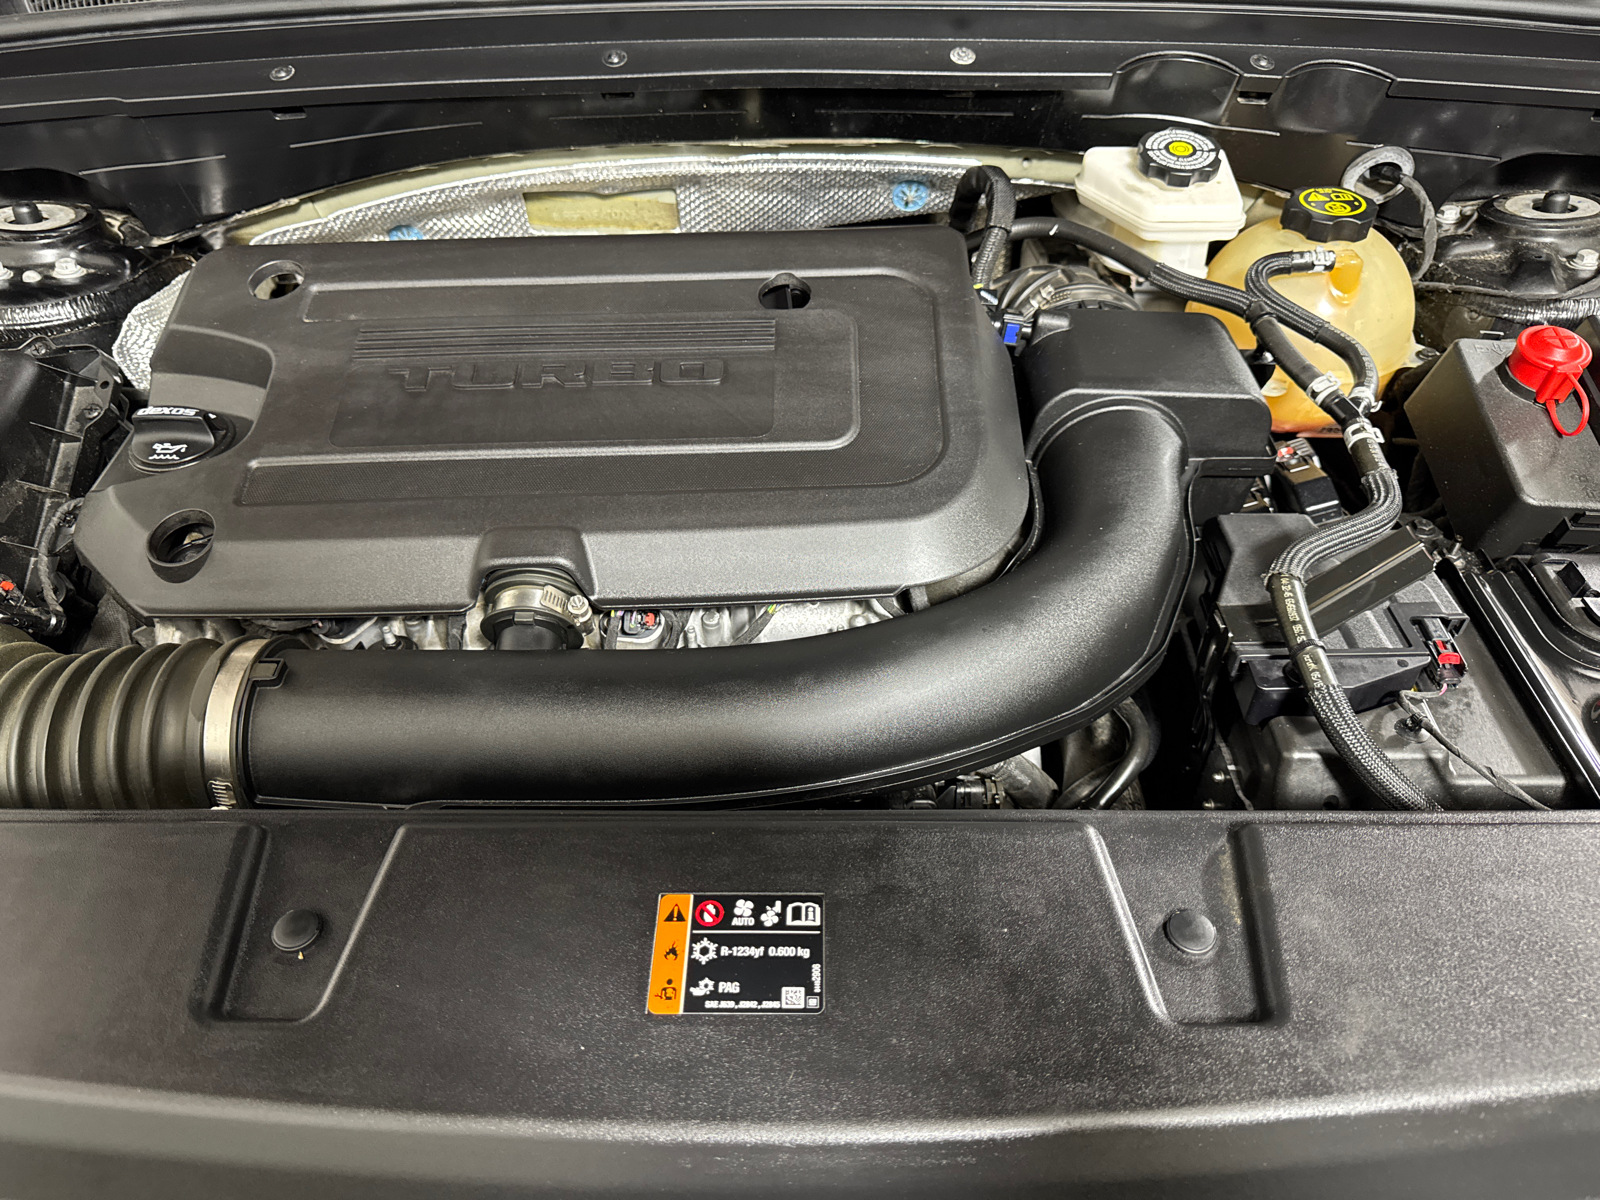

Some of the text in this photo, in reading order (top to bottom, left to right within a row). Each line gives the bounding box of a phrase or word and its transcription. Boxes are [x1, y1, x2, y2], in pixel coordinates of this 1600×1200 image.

[388, 359, 725, 391] TURBO
[136, 405, 200, 416] dexos
[731, 917, 755, 926] AUTO
[720, 945, 810, 959] R-1234yf 0.600 kg
[718, 981, 740, 994] PAG
